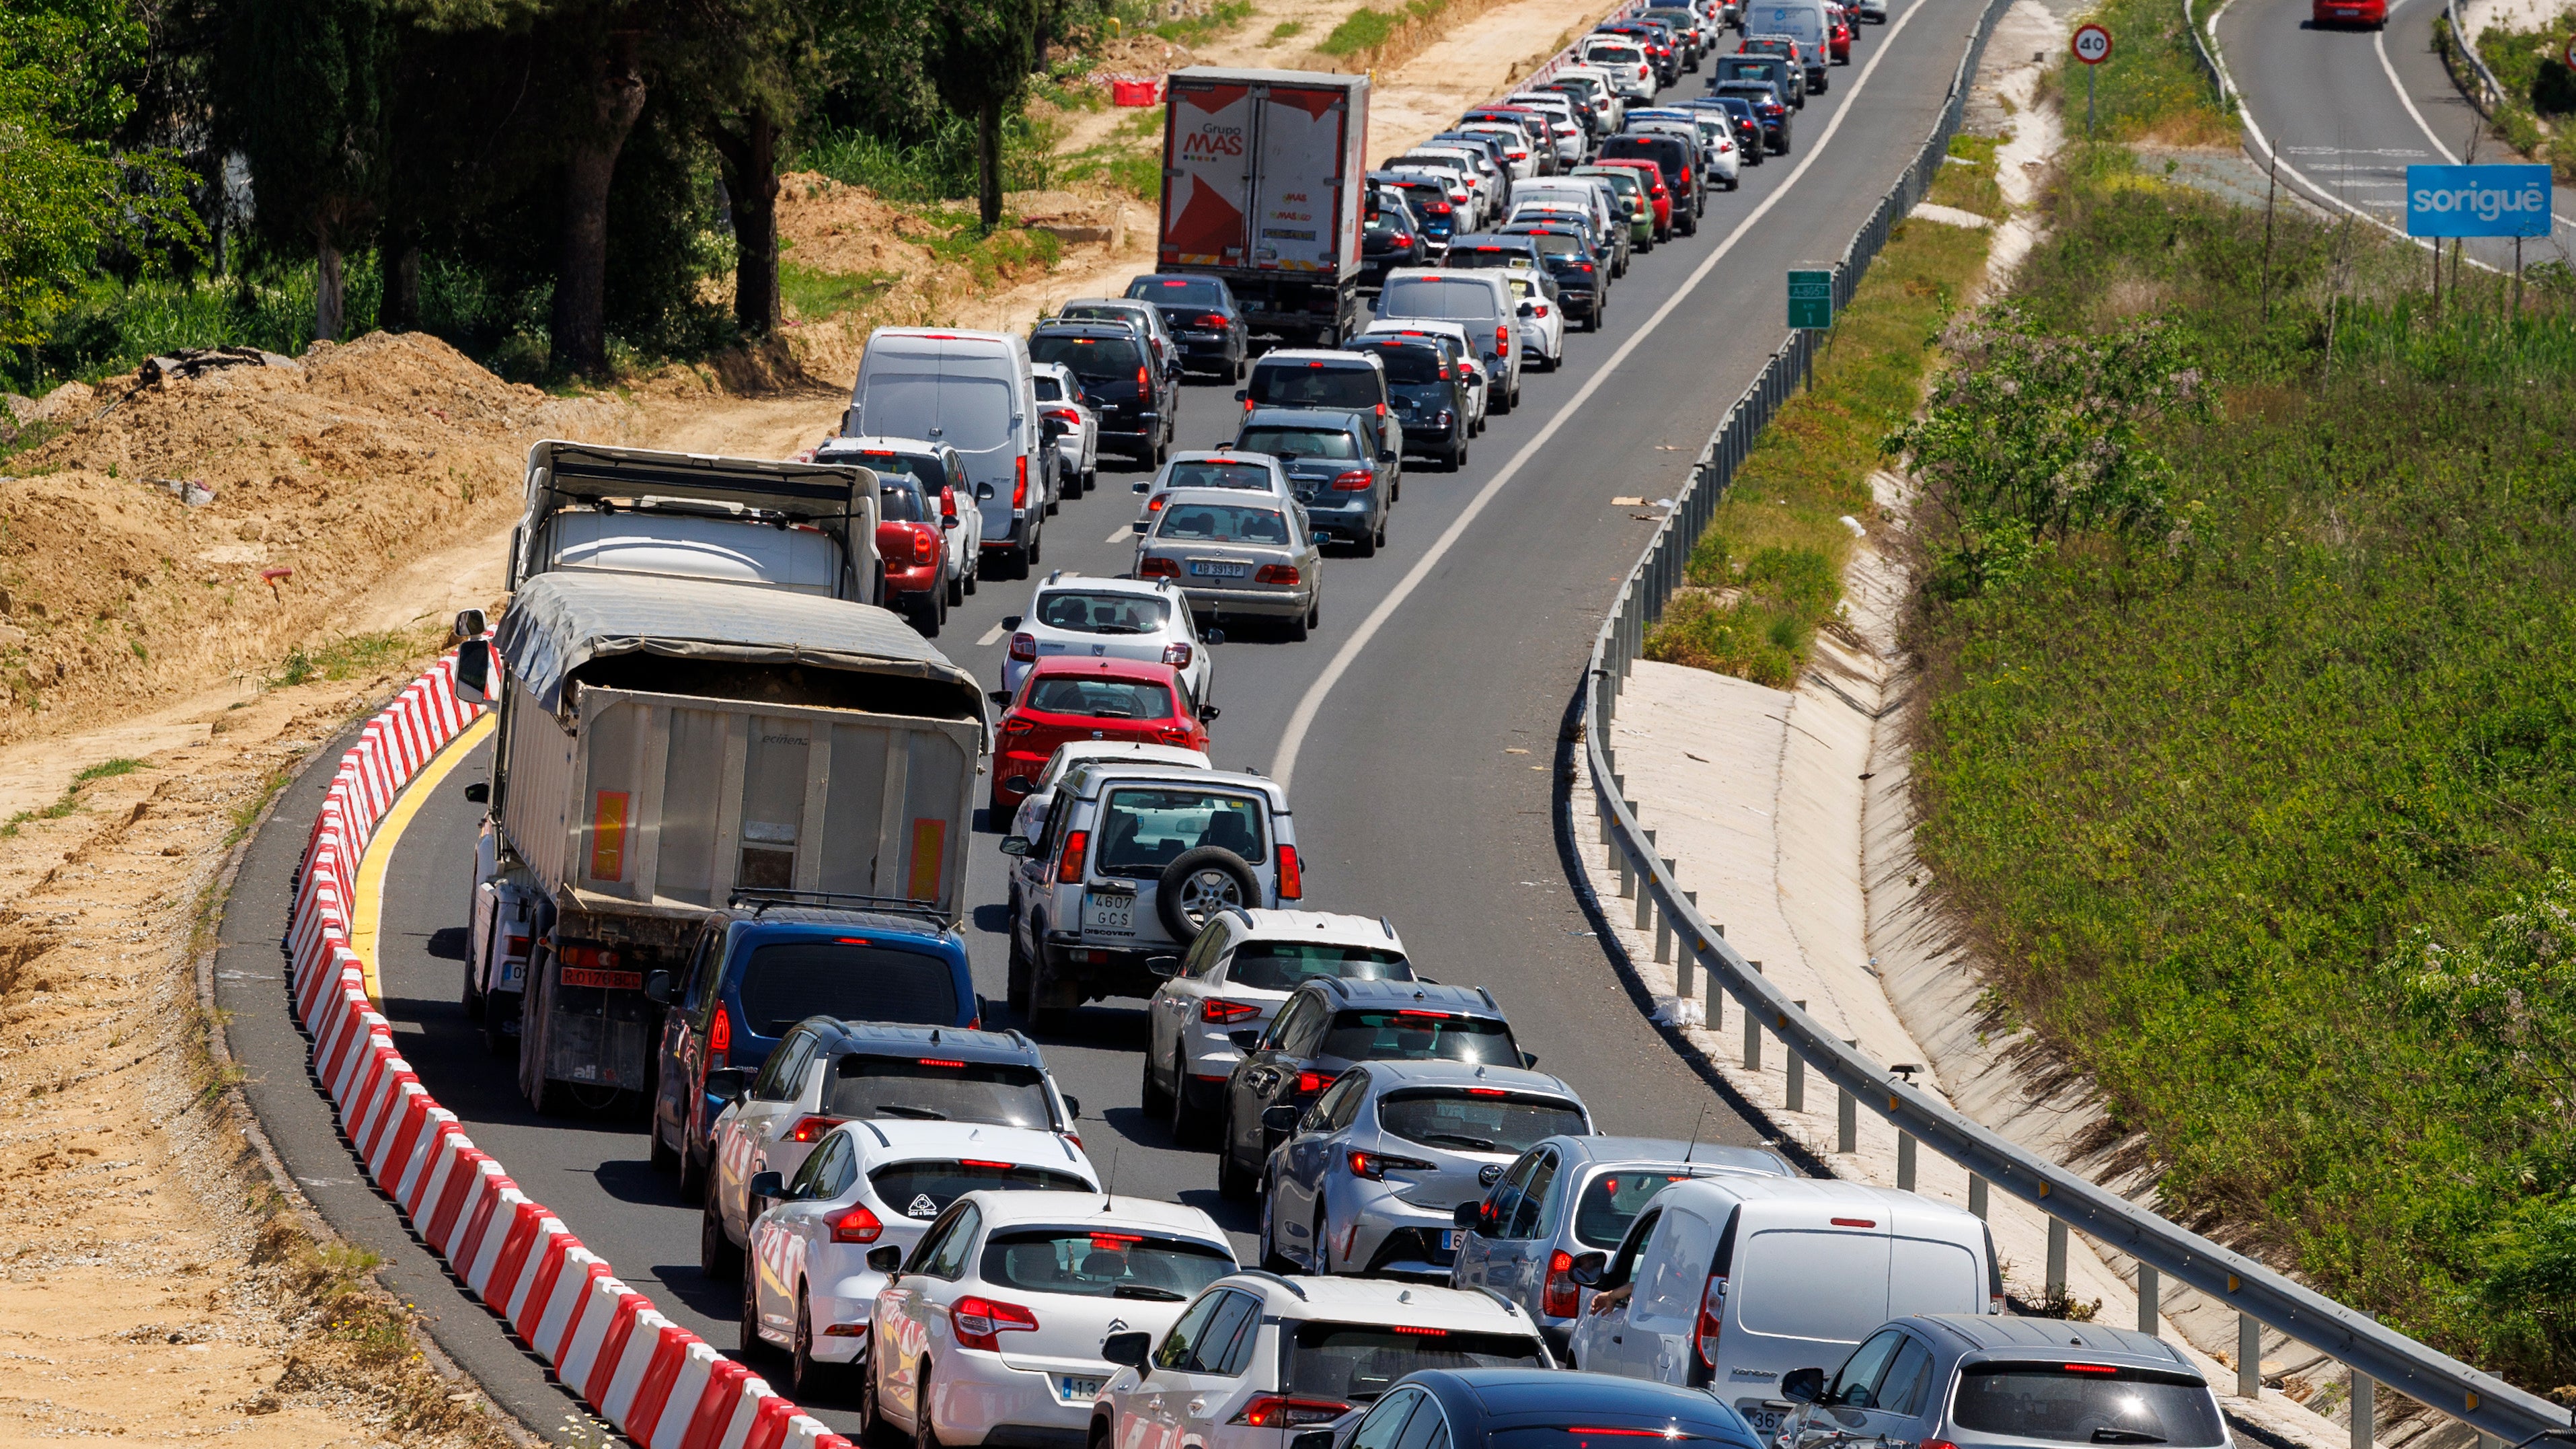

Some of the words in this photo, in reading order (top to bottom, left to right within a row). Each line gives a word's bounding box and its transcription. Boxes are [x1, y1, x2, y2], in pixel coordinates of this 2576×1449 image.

[2080, 37, 2105, 51] 40
[1203, 123, 1242, 137] Grupo
[1183, 131, 1243, 156] MAS
[1807, 311, 1813, 324] 1
[1096, 895, 1132, 909] 4607
[1098, 912, 1129, 926] GCS
[1084, 929, 1136, 937] DISCOVERY
